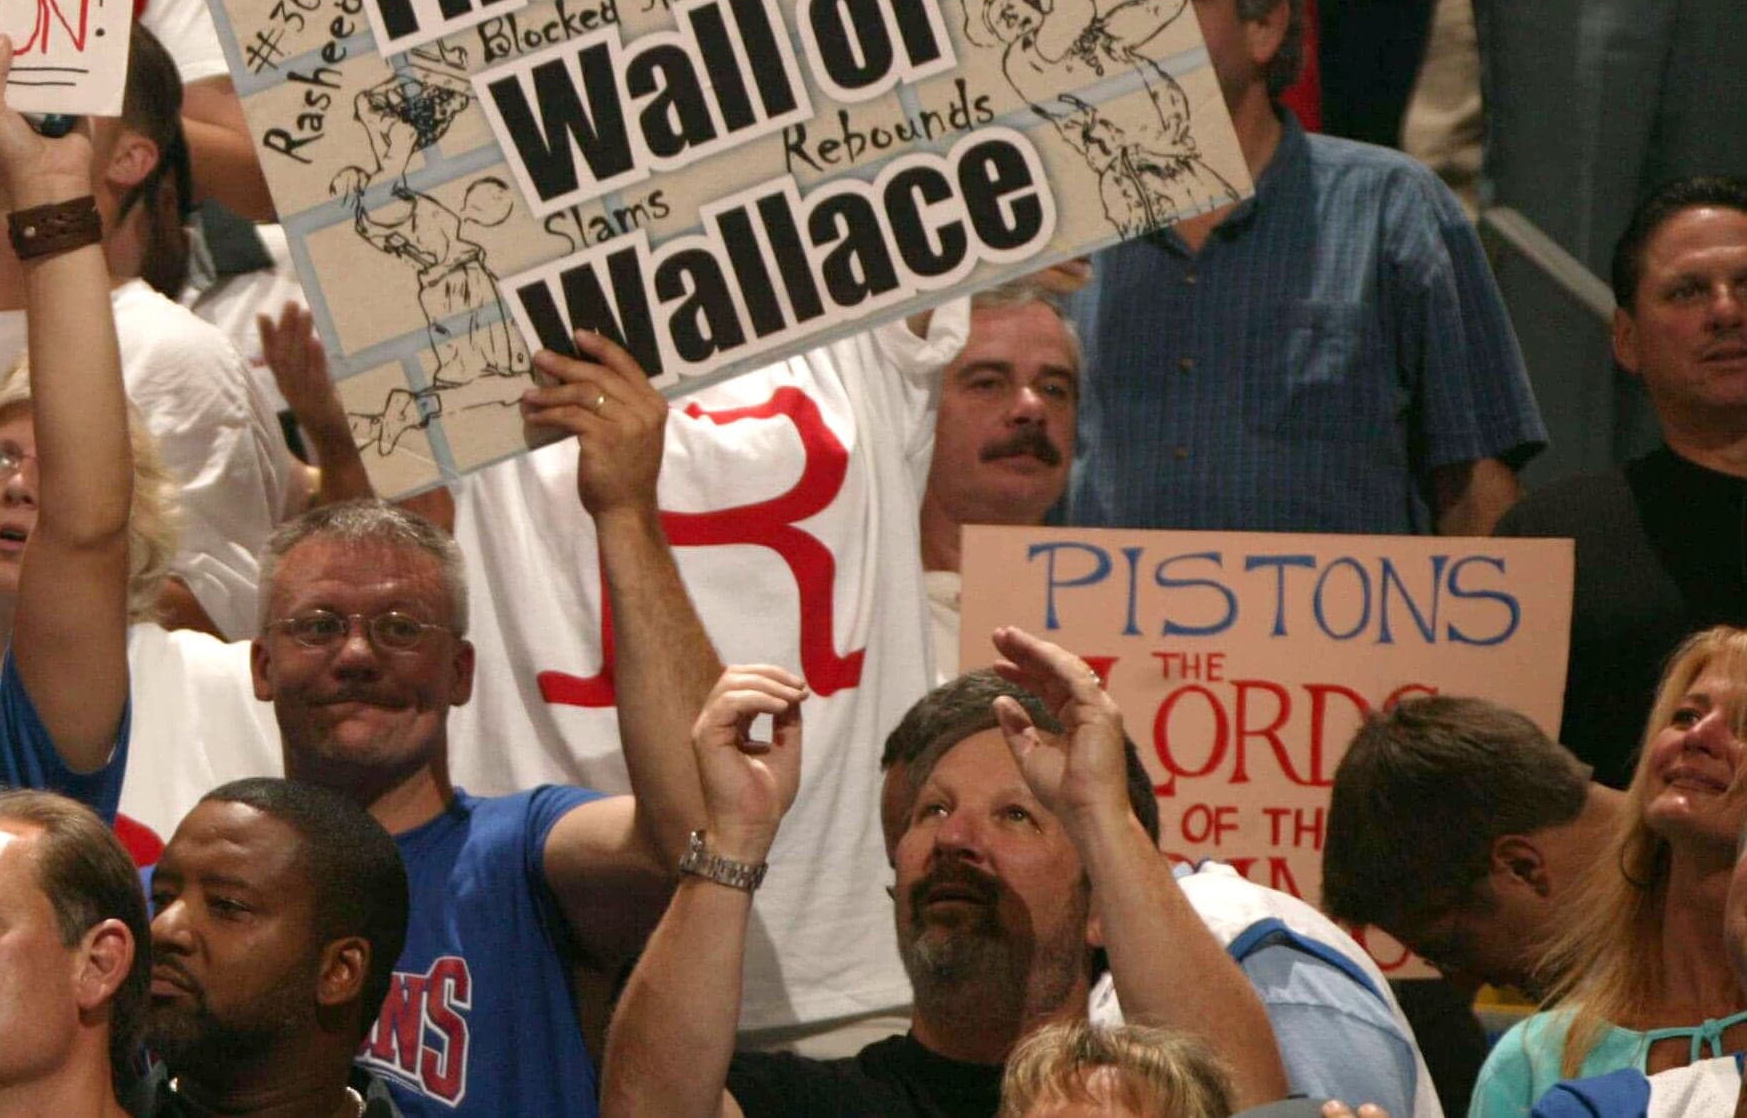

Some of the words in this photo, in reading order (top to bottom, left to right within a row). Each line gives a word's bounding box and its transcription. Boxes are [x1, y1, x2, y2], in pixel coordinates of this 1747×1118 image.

[478, 0, 621, 63] Blocked
[782, 78, 995, 175] Rebounds
[516, 139, 1044, 379] Wallace
[544, 189, 670, 255] Slams
[1028, 542, 1521, 647] PISTONS
[1151, 652, 1226, 682] THE
[1079, 656, 1439, 797] ORD
[1181, 803, 1239, 846] OF
[1262, 806, 1325, 851] TH
[355, 955, 472, 1108] NS
